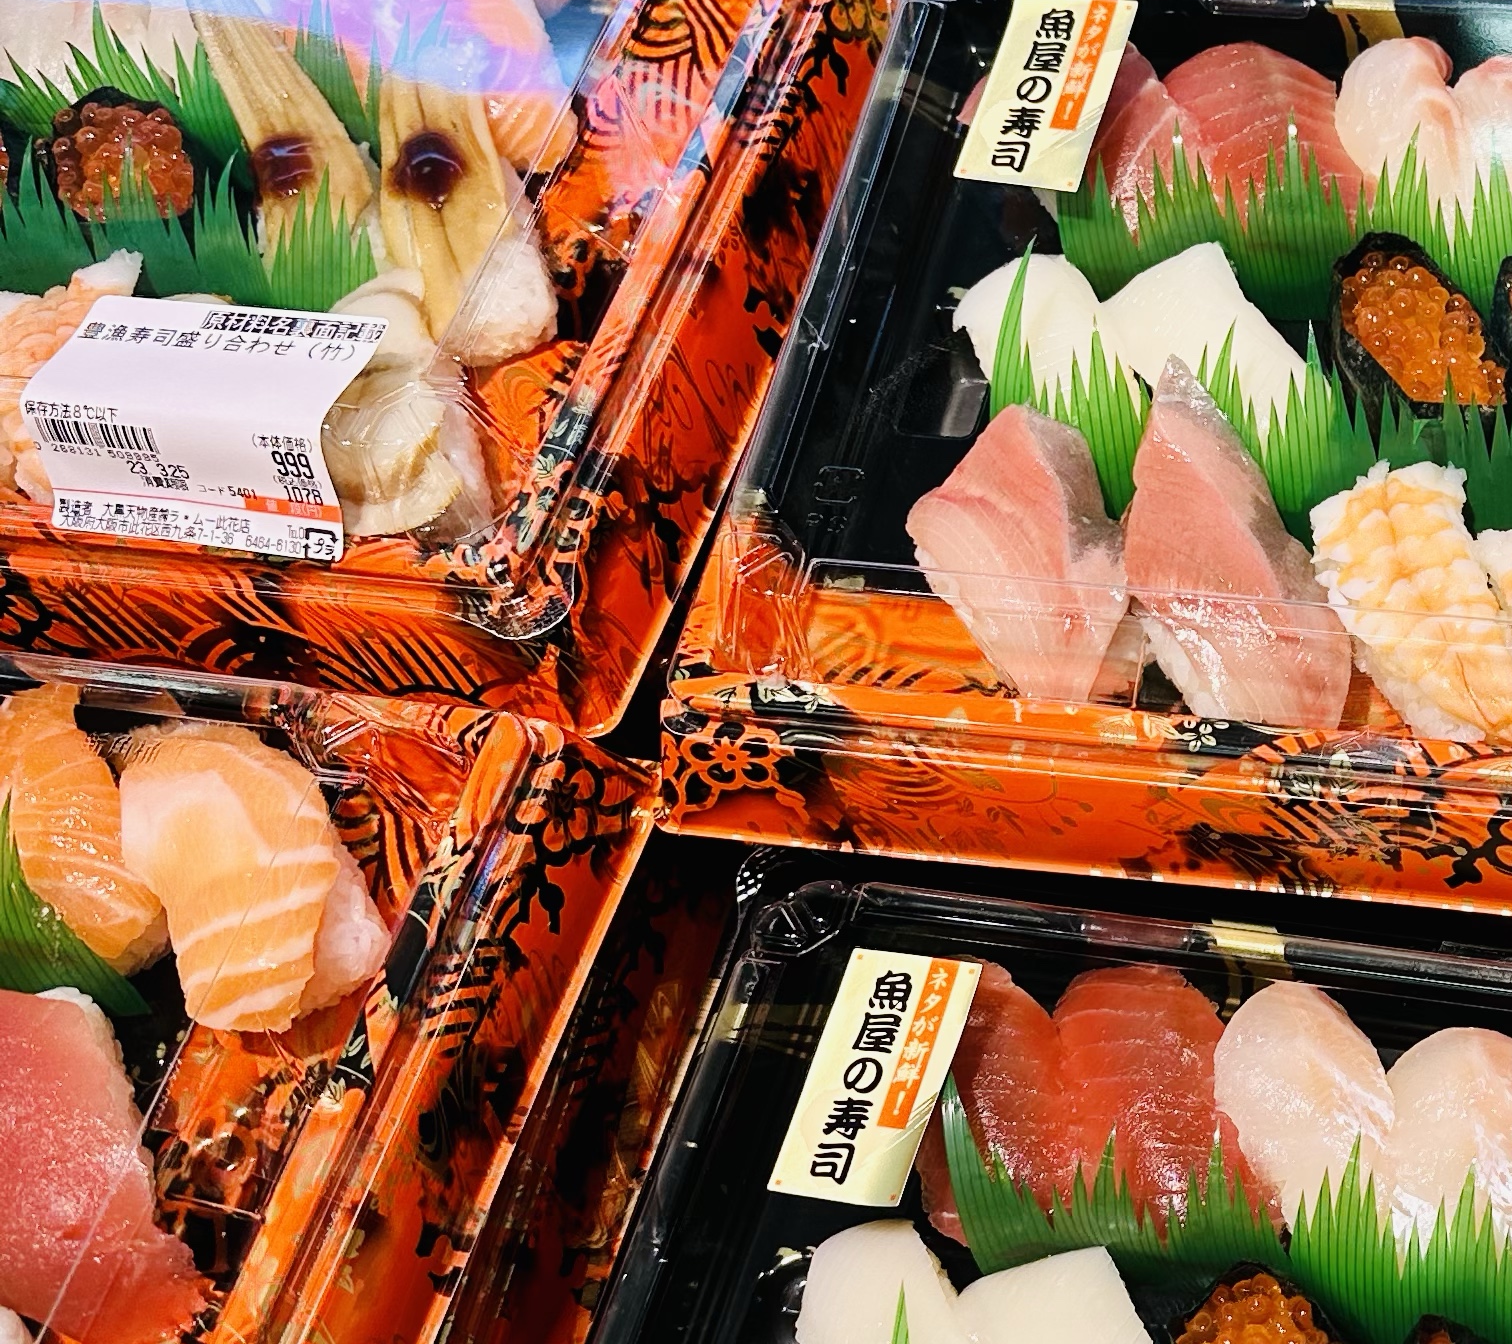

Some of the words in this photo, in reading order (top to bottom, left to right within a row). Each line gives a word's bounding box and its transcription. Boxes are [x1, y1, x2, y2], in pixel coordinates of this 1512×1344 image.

[992, 9, 1075, 173] 魚屋の寿司
[1062, 4, 1107, 121] ネタが新鮮！
[271, 451, 314, 479] 999
[284, 486, 323, 505] 1078
[810, 970, 912, 1185] 魚屋の寿司
[892, 968, 949, 1115] ネタが新鮮！
